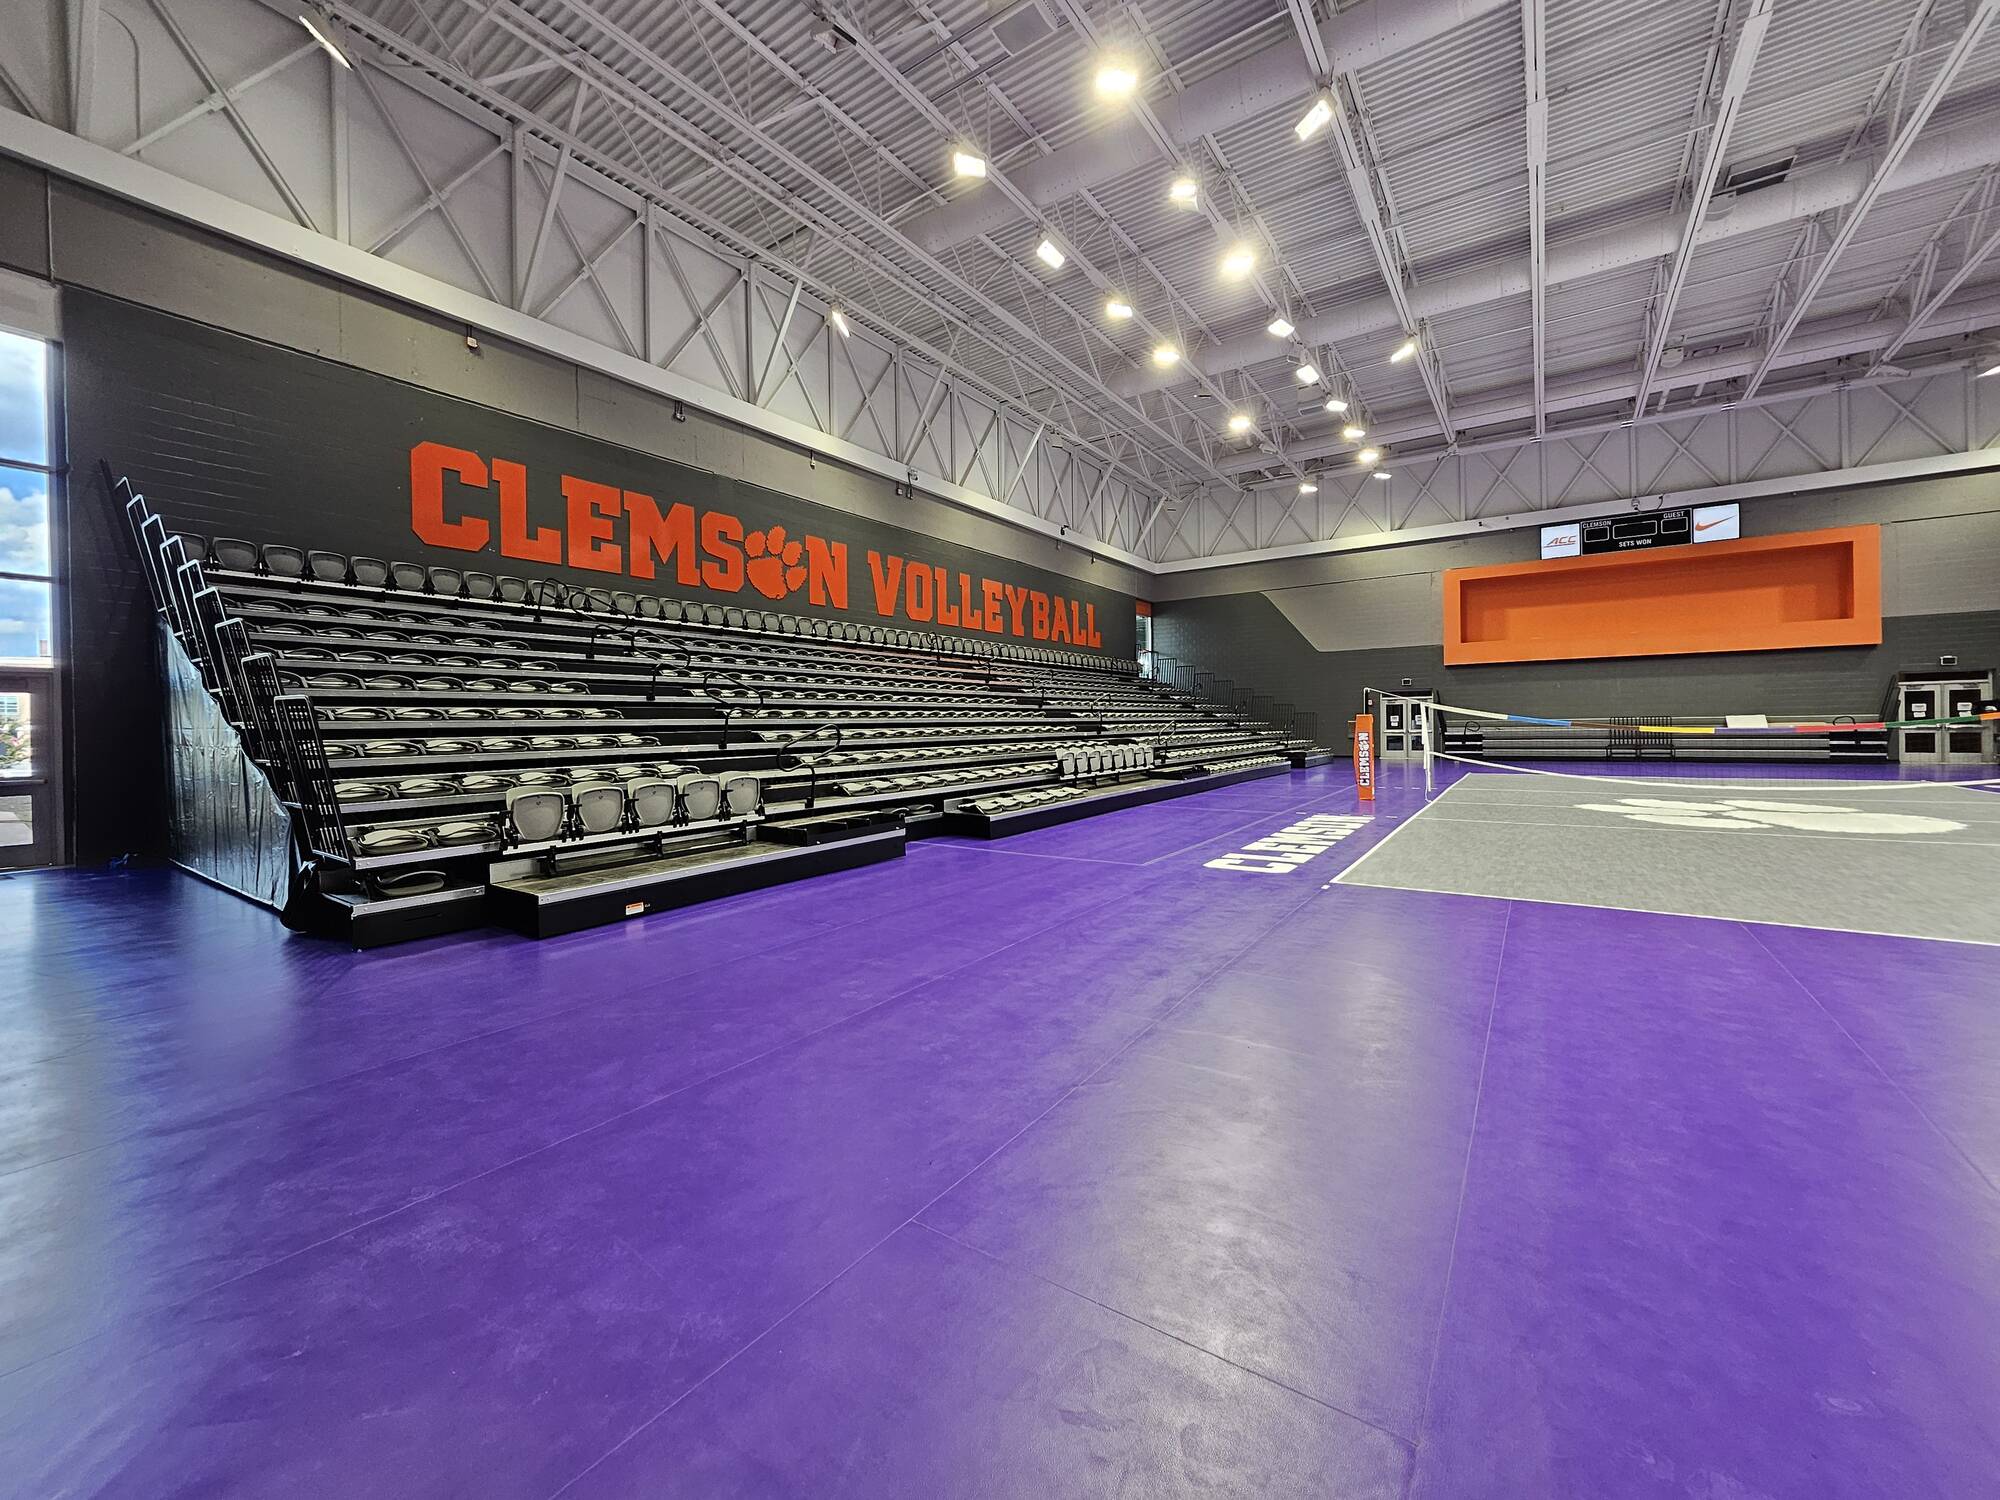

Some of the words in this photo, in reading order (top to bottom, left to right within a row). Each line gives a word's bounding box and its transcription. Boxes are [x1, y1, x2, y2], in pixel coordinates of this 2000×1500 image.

[1663, 511, 1685, 519] GUEST
[1582, 520, 1612, 529] CLEMSON
[1546, 535, 1577, 546] ACC
[1636, 538, 1652, 546] WON
[868, 550, 1101, 648] VOLLEYBALL
[1203, 814, 1376, 873] CLEMSON
